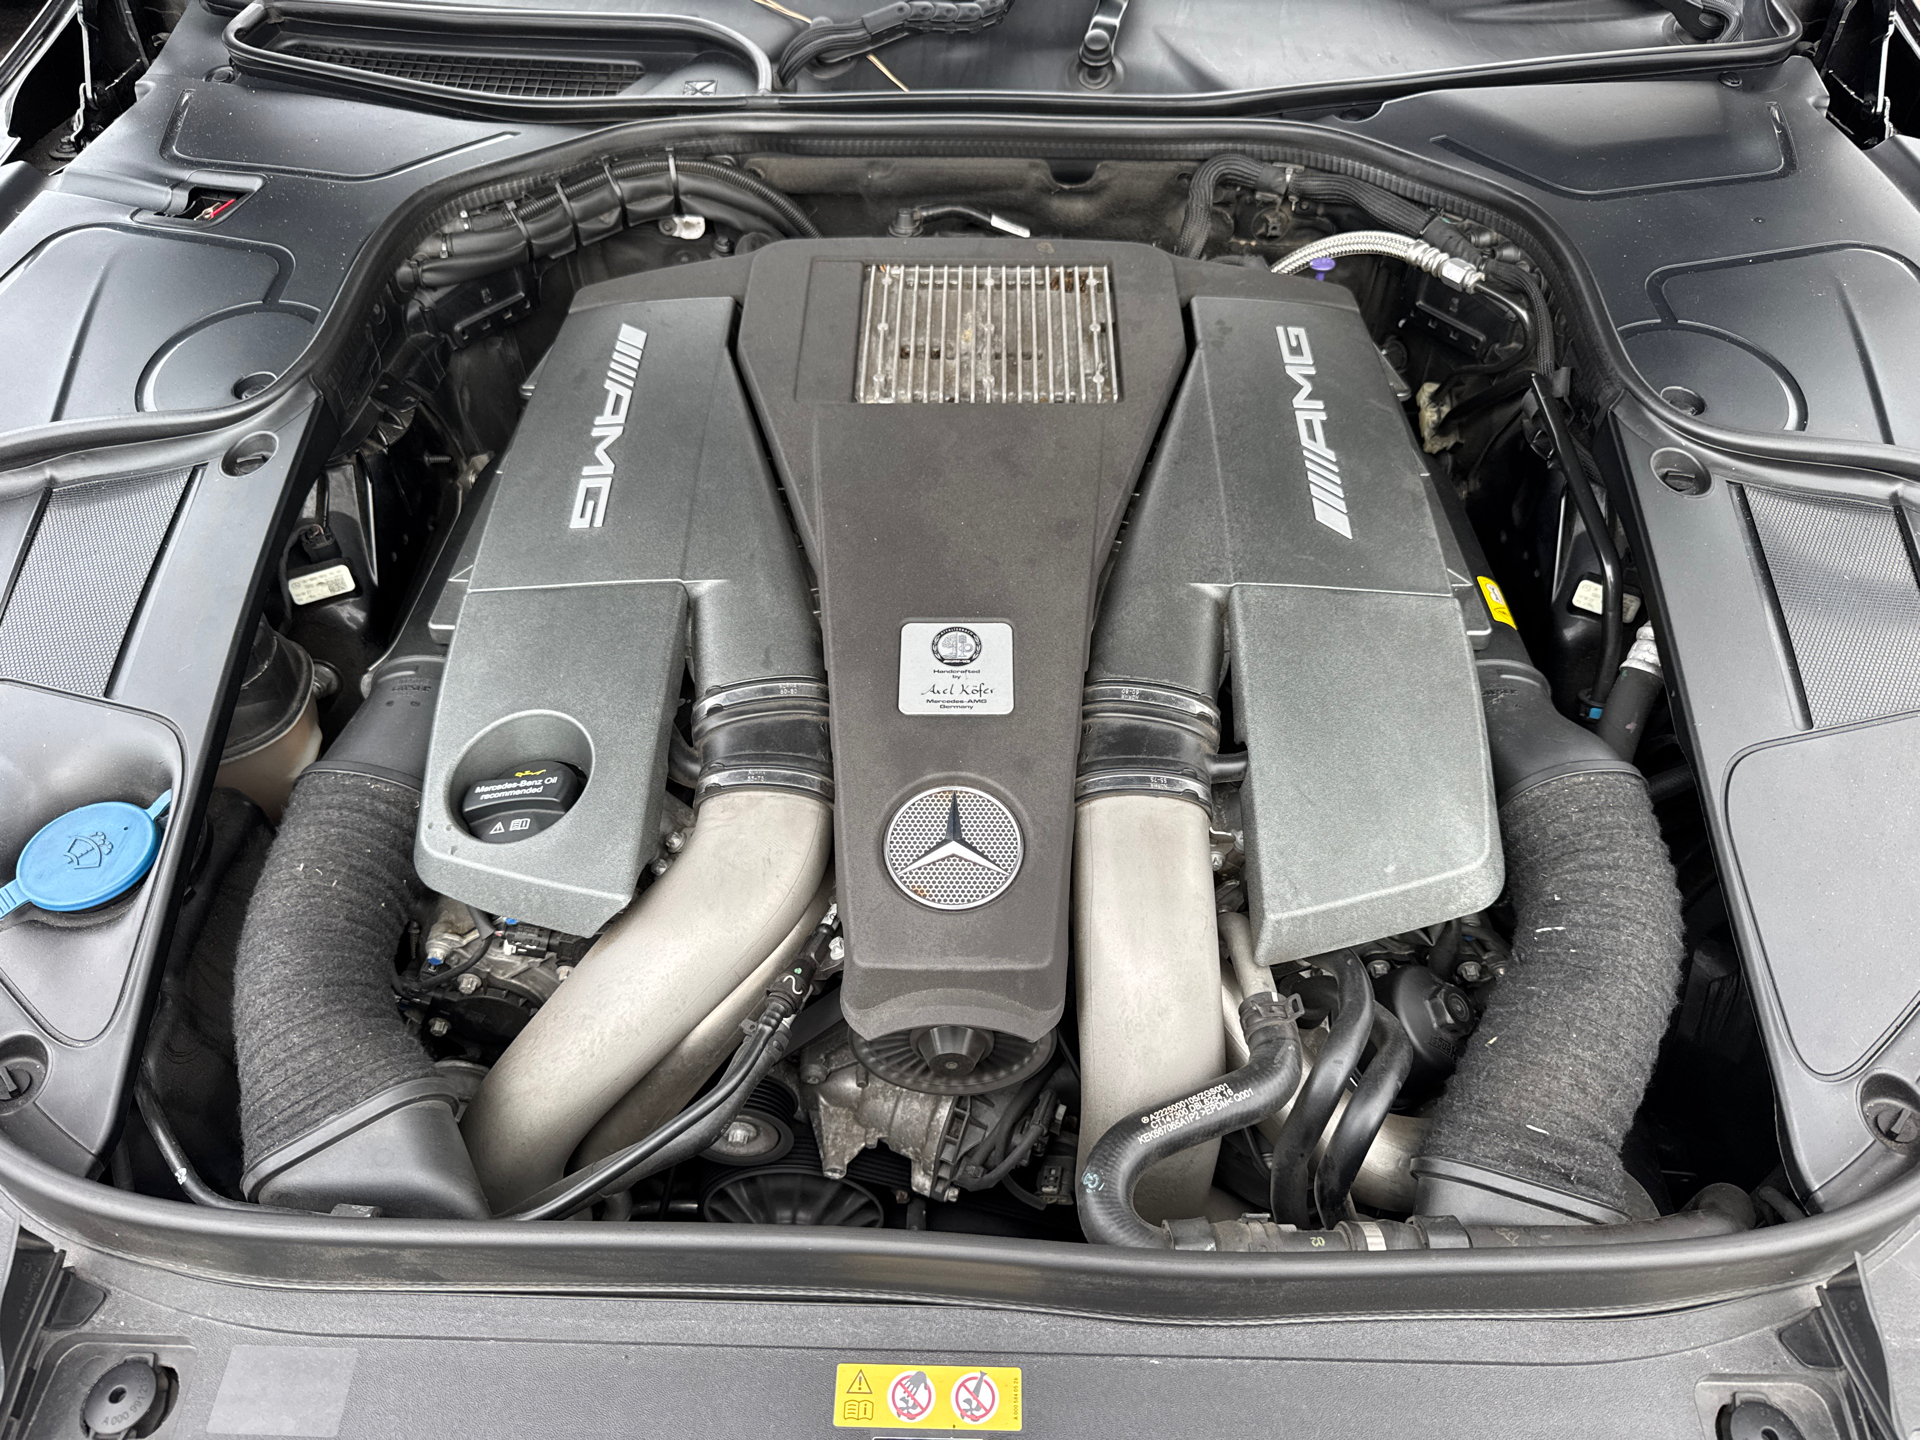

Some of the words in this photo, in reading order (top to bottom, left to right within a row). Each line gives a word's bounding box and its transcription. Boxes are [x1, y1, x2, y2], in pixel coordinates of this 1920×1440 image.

[1275, 326, 1337, 462] AMG
[569, 378, 635, 528] AMG
[920, 683, 954, 696] Axel
[959, 682, 995, 698] Köfer
[474, 779, 543, 794] Mercedes-Benz
[543, 776, 558, 785] Oil
[480, 786, 544, 800] recommended
[1149, 1082, 1230, 1121] A2225000105/ZGS001
[1233, 1087, 1254, 1103] Q001
[1150, 1107, 1189, 1129] CT147300
[101, 1416, 109, 1426] A
[110, 1411, 130, 1426] 000
[129, 1396, 146, 1413] 991
